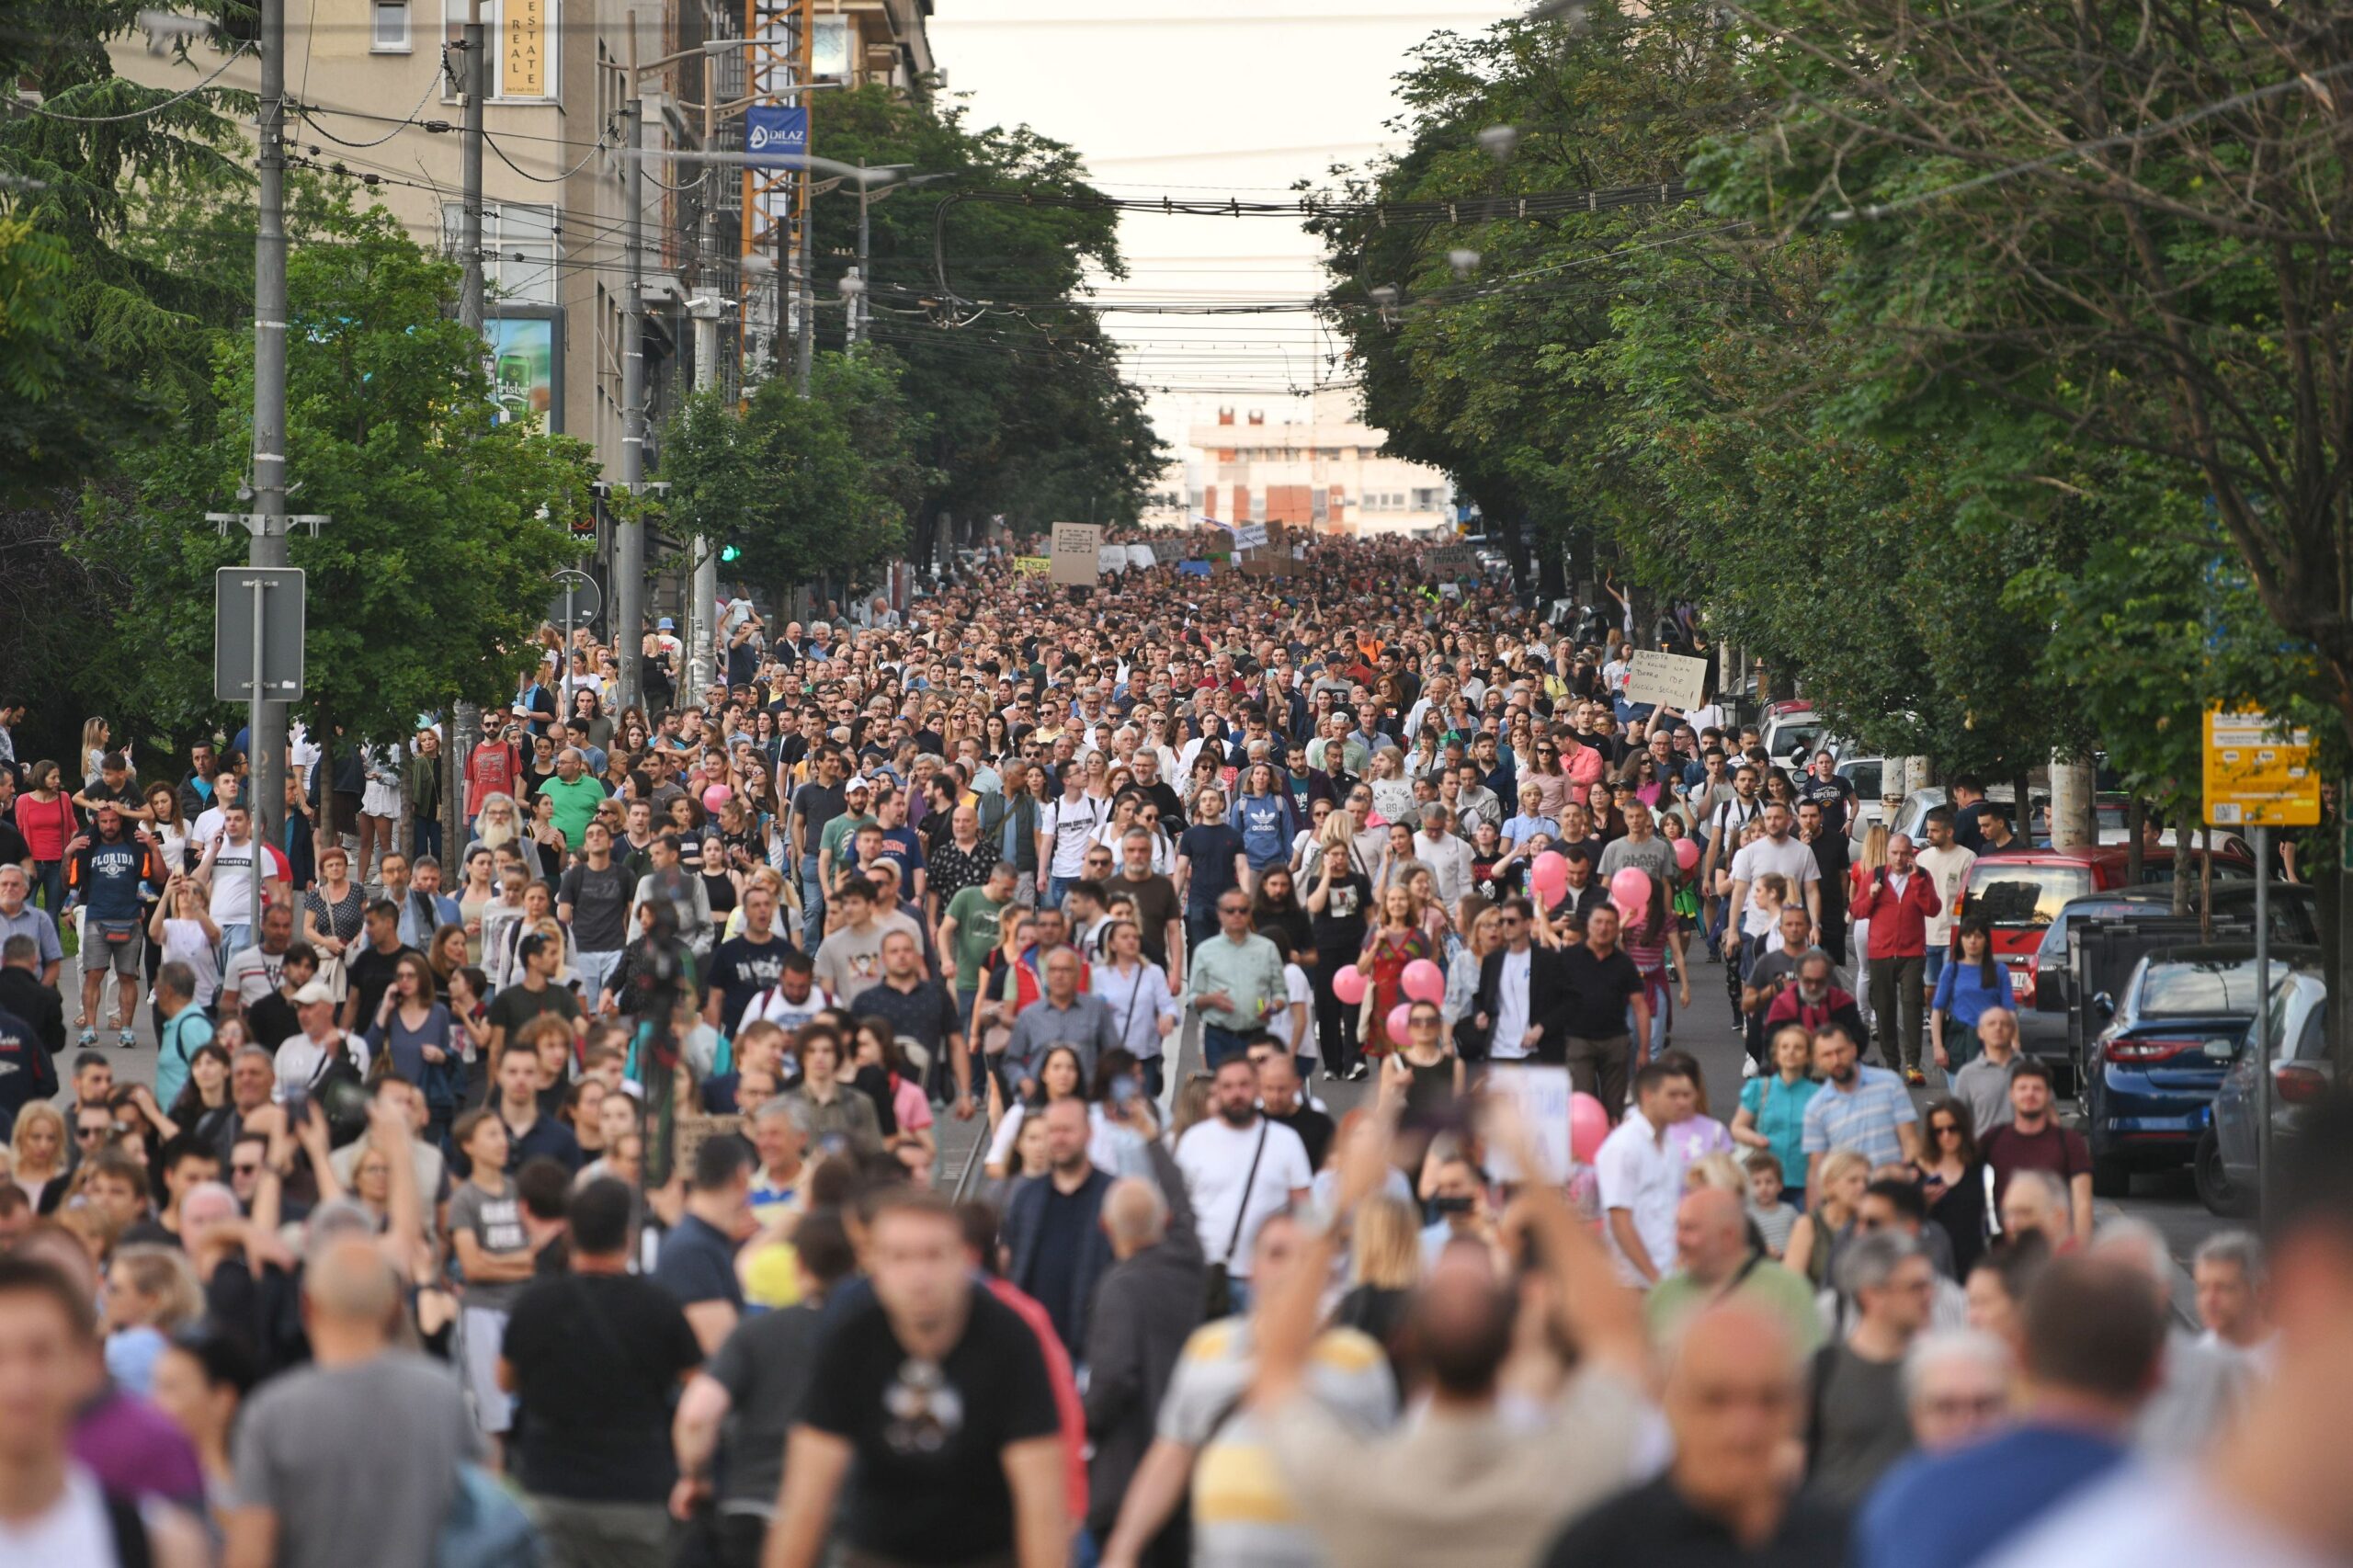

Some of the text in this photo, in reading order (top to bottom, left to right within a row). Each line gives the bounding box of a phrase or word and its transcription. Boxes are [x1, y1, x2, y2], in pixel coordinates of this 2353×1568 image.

[511, 19, 520, 73] REAL
[527, 2, 536, 84] ESTATE
[91, 852, 134, 867] FLORIDA
